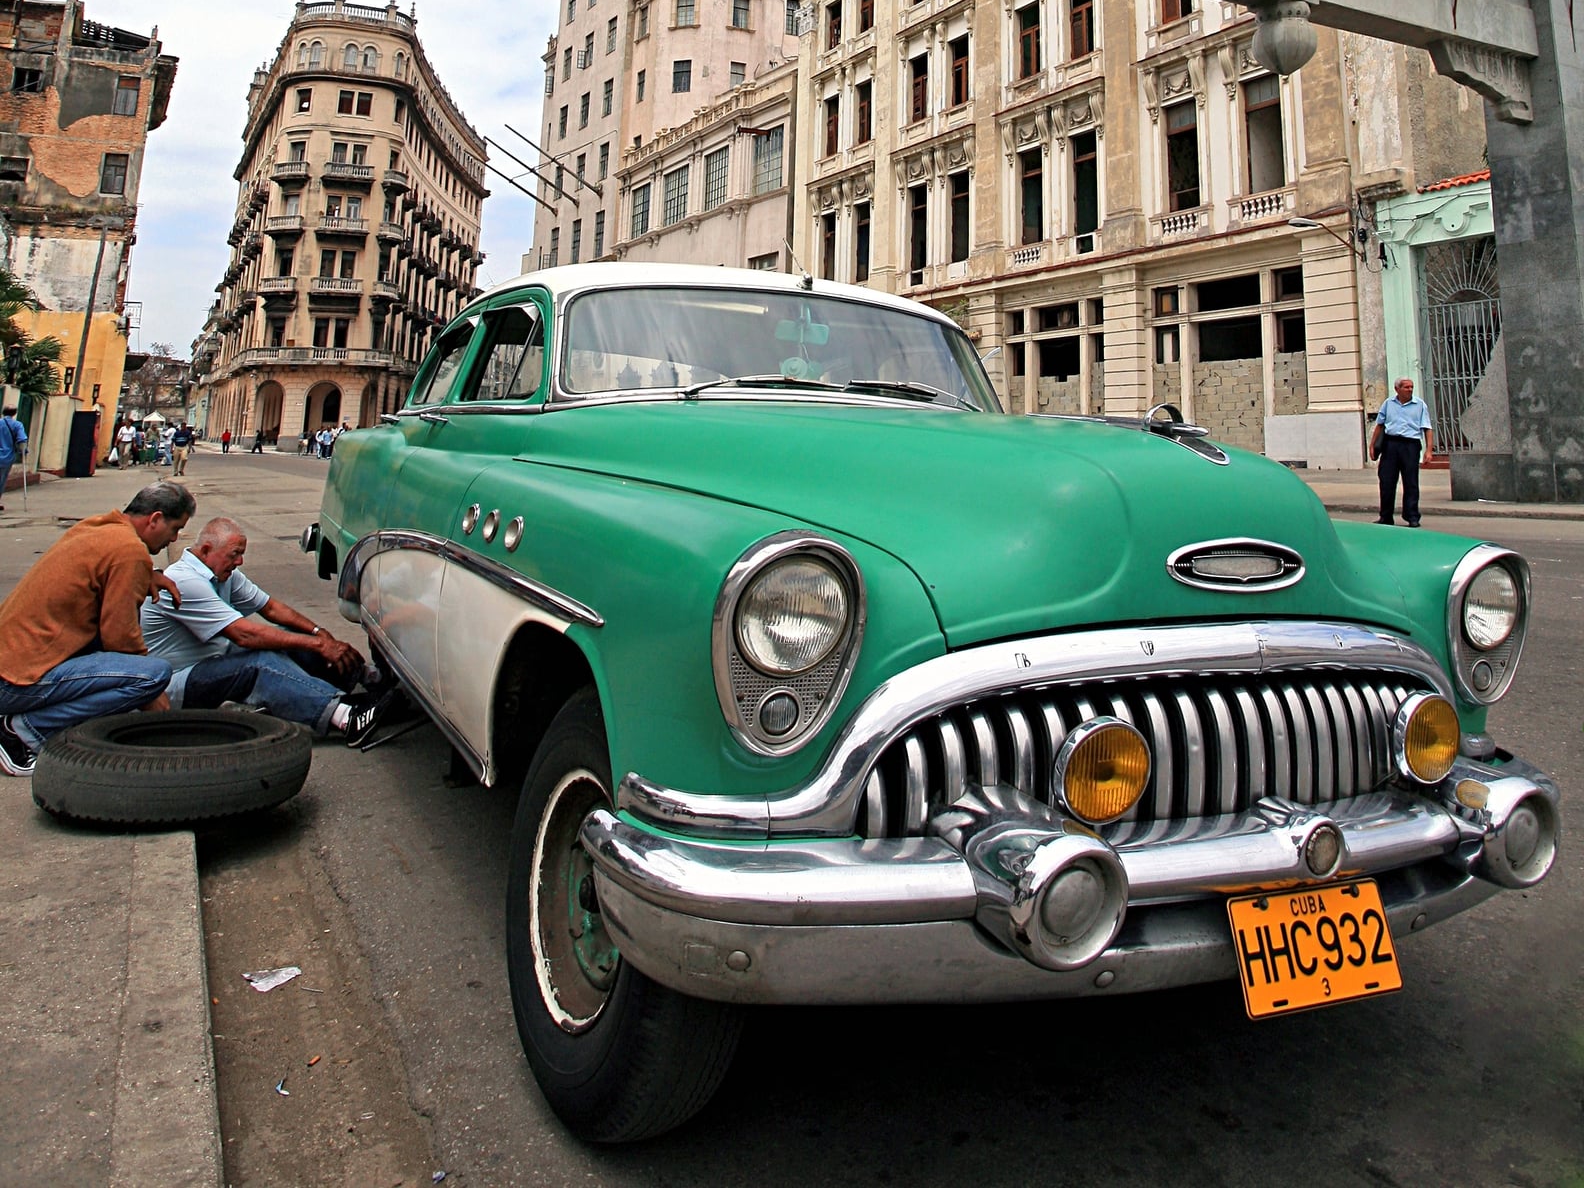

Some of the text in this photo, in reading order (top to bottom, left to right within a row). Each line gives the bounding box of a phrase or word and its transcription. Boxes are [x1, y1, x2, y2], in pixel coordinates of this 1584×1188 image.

[1290, 894, 1327, 916] CUBA
[1238, 908, 1393, 987] HHC932
[1321, 977, 1331, 996] 3
